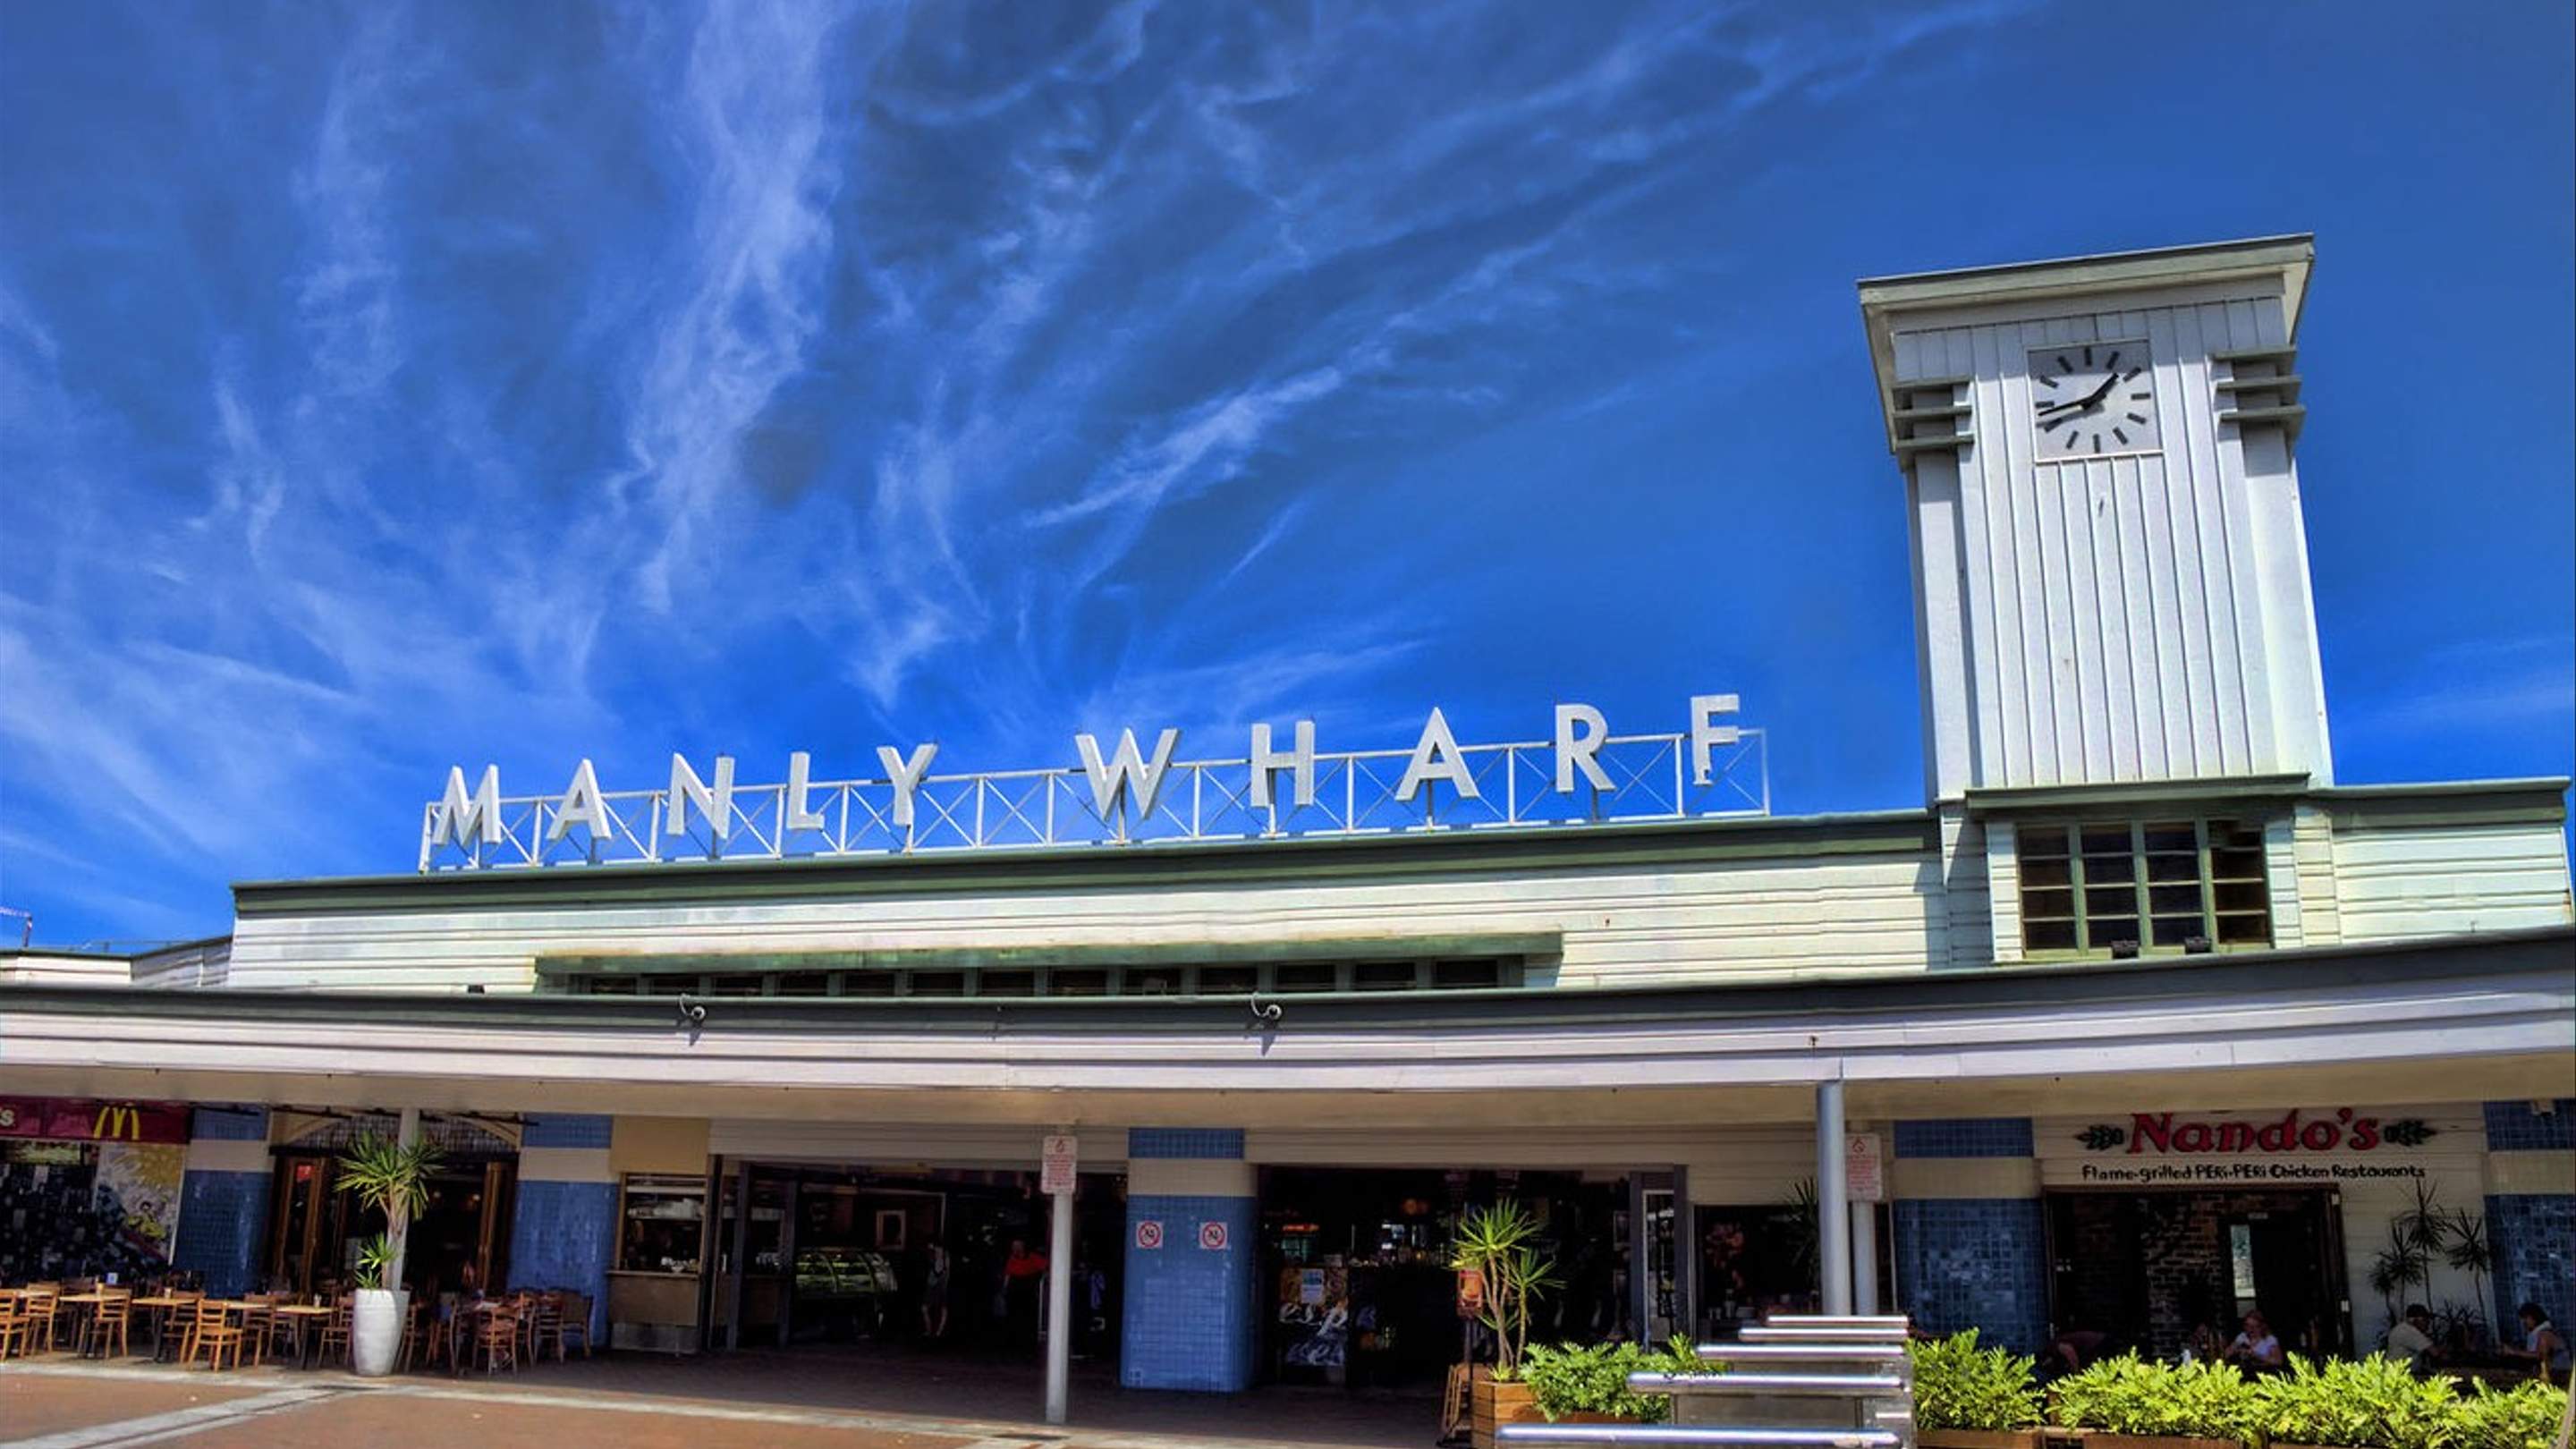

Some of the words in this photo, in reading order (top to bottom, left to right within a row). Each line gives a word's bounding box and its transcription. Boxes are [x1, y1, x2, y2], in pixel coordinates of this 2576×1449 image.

[432, 742, 939, 845] MANLY
[1075, 693, 1740, 821] WHARF
[2126, 1106, 2380, 1154] Nando's
[2081, 1164, 2192, 1182] Flame-grilled
[2269, 1165, 2330, 1179] Chicken
[2332, 1164, 2427, 1179] Restaurants
